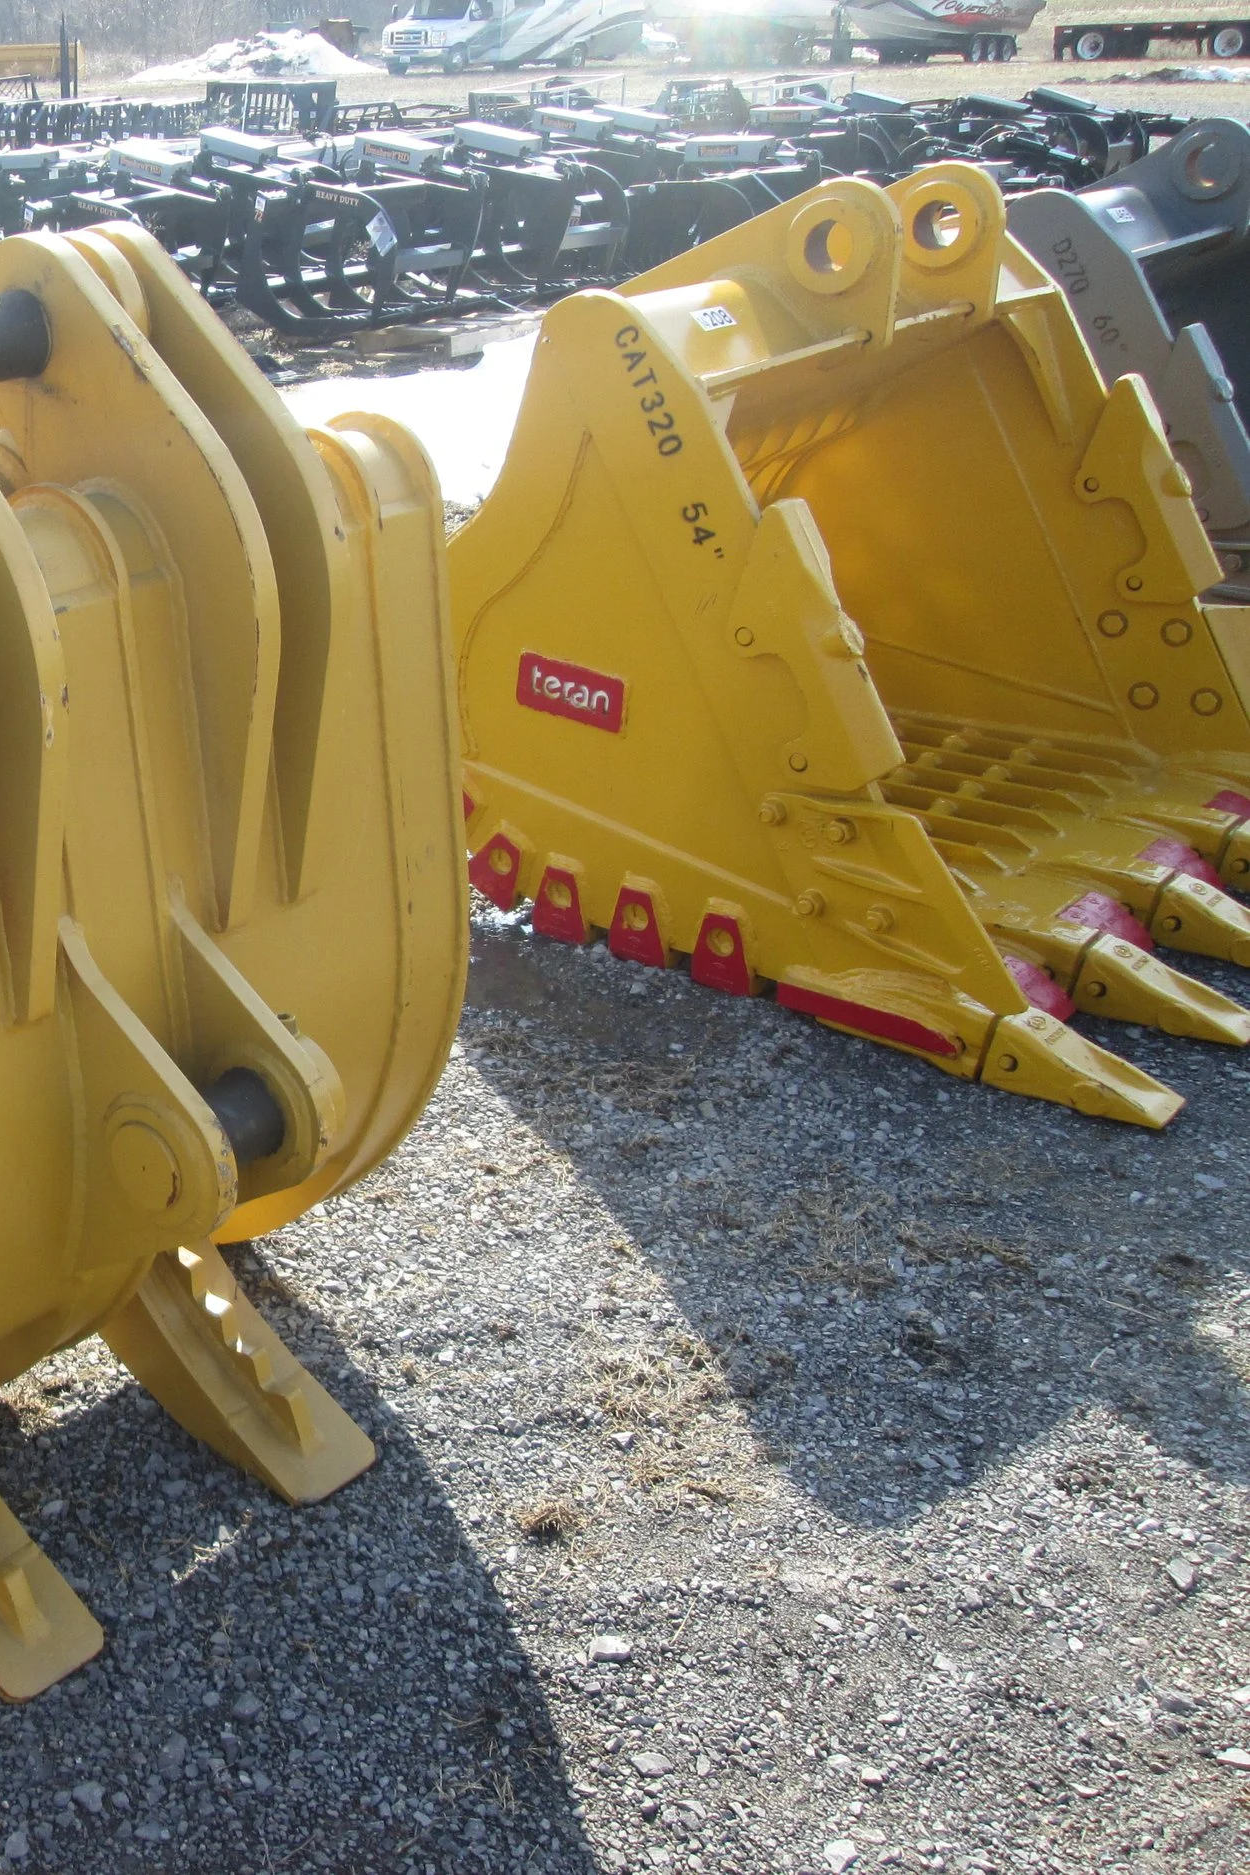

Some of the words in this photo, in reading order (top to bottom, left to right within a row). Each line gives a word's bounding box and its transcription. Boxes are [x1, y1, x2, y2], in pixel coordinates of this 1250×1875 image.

[78, 201, 99, 212] HEAVY
[100, 207, 118, 217] DUTY
[315, 190, 338, 202] HEAVY
[339, 195, 360, 206] DUTY
[1053, 238, 1089, 294] D270
[614, 325, 683, 457] CAT320
[682, 502, 724, 559] 54"
[532, 665, 609, 714] teran
